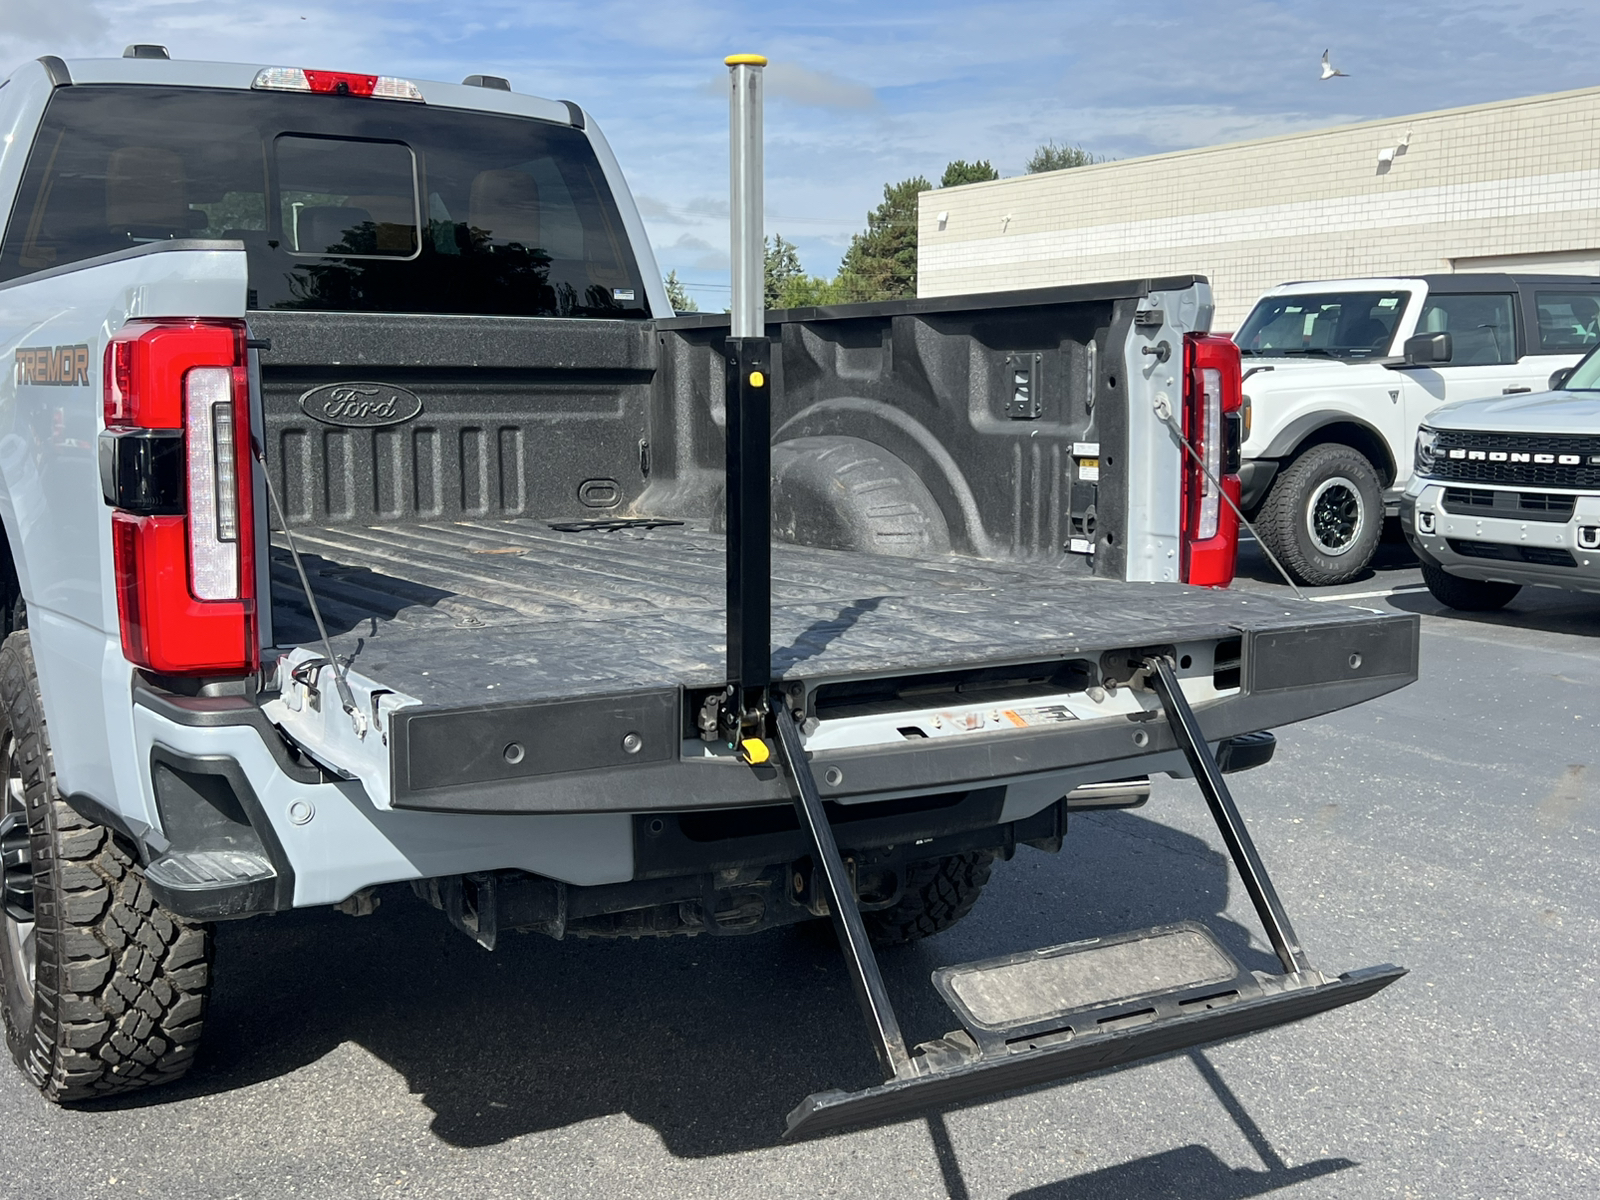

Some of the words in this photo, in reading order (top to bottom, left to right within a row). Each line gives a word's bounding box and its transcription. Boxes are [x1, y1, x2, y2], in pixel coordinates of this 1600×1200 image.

[15, 344, 89, 386] TREMOR
[323, 387, 398, 418] Ford
[1449, 449, 1580, 465] BRONCO
